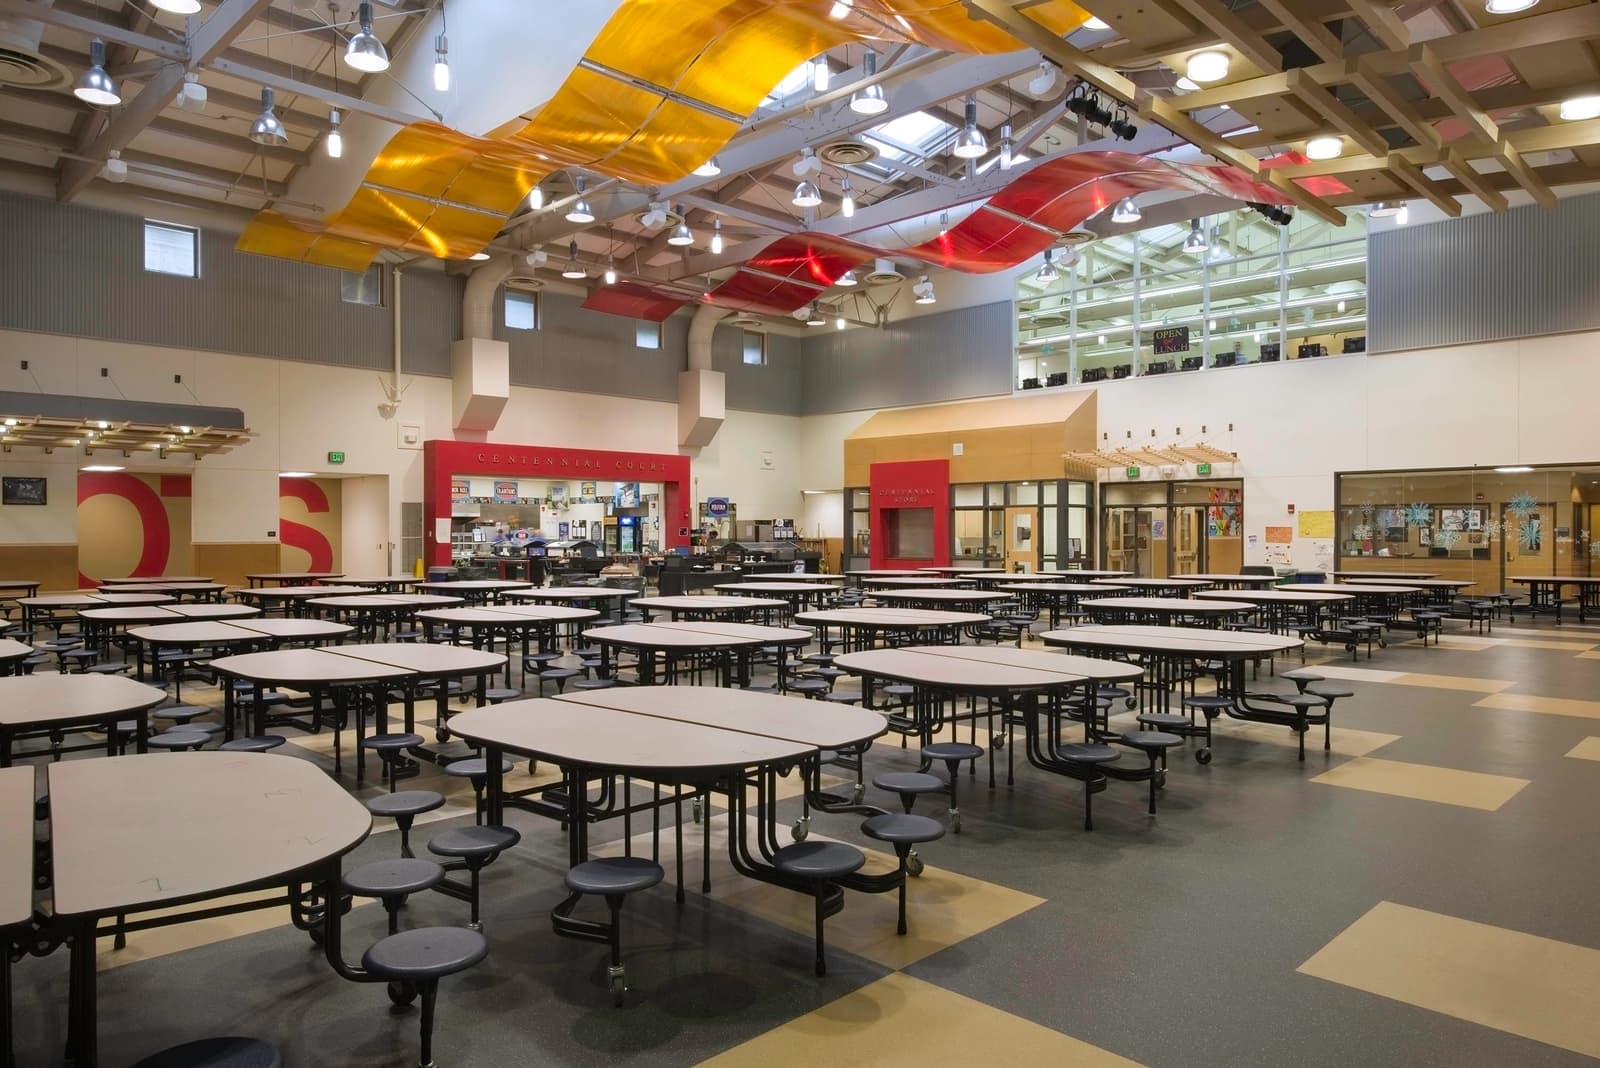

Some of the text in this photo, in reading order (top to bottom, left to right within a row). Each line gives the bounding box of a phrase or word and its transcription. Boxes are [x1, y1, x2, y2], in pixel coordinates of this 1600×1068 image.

[1155, 328, 1184, 340] OPEN
[1155, 343, 1188, 354] LUNCH
[478, 453, 667, 471] CENTENNIAL COURT
